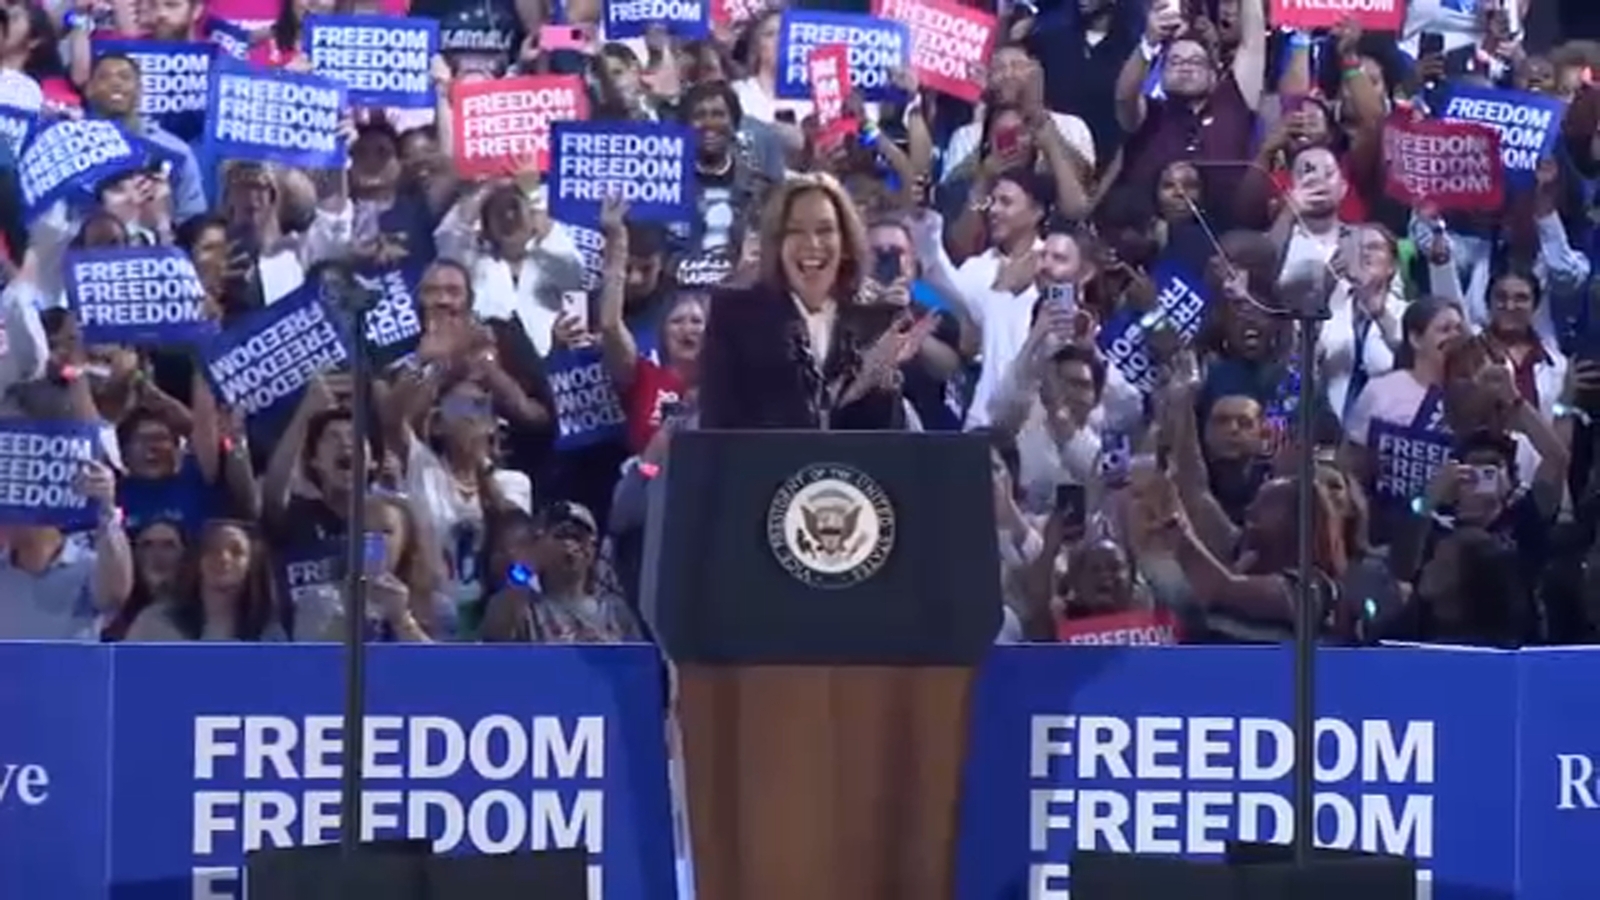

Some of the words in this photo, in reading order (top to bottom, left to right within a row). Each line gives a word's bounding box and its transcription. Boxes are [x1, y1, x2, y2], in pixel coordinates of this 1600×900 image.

[610, 1, 700, 21] FREEDOM
[312, 26, 428, 47] FREEDOM
[789, 22, 902, 47] FREEDOM
[910, 24, 982, 60] EDOM
[127, 53, 209, 73] EDOM
[311, 47, 428, 70] FREEDOM
[139, 74, 208, 92] EDOM
[219, 75, 340, 108] FREEDOM
[313, 69, 428, 93] EEDOM
[139, 94, 207, 112] EDOM
[217, 97, 338, 130] FREEDOM
[462, 88, 576, 117] FREEDOM
[1446, 97, 1553, 129] FREEDOM
[215, 119, 337, 152] FREEDOM
[464, 110, 577, 138] FREEDO
[561, 132, 683, 157] FREEDOM
[560, 156, 682, 181] FREEDOM
[77, 278, 206, 302] FREEDOM
[210, 300, 324, 381] FREEDOM
[1378, 433, 1455, 463] FREE
[193, 715, 605, 779] FREEDOM
[1029, 715, 1435, 783] FREEDOM
[1556, 753, 1600, 809] R
[192, 789, 604, 854] FREEDOM
[1028, 789, 1434, 858] FREEDOM
